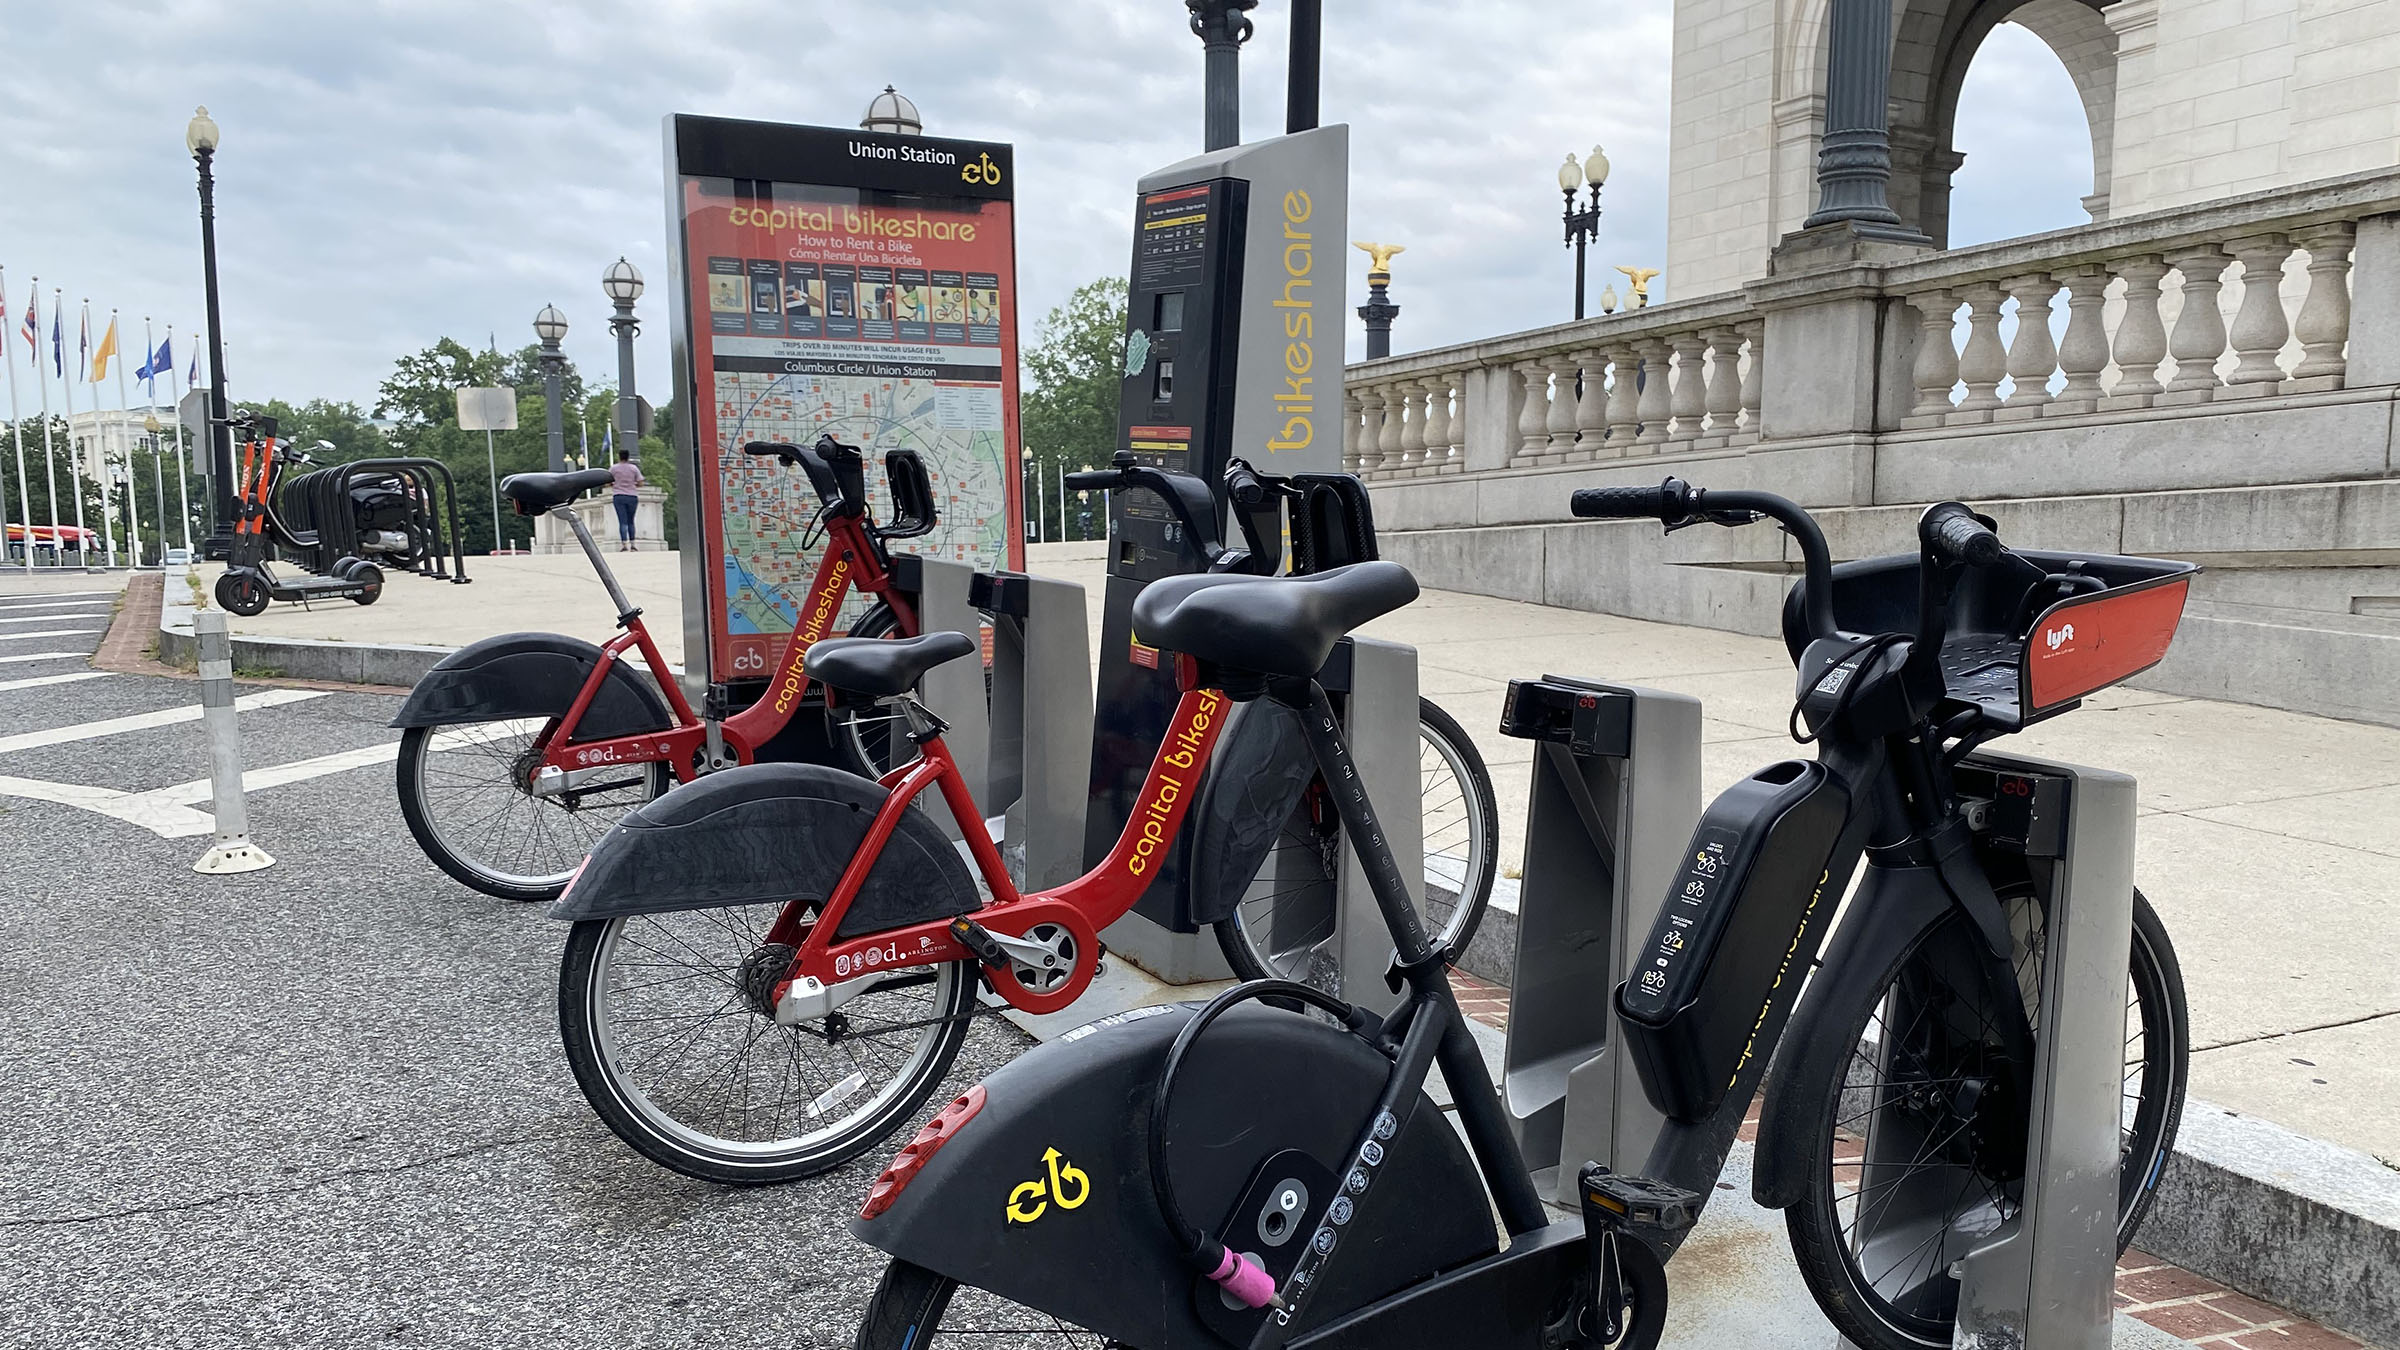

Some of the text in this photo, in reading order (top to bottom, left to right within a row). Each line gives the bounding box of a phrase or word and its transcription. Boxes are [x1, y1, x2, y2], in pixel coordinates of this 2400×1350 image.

[848, 141, 956, 165] Union Station
[728, 204, 976, 242] capital bikeshare
[798, 234, 913, 253] How to Rent a Bike
[789, 247, 922, 267] Cómo Rentar Una Bicicleta
[1265, 188, 1314, 455] bikeshare
[782, 341, 801, 349] TRIPS
[802, 342, 822, 350] OVER
[784, 361, 835, 374] Columbus
[836, 363, 865, 375] Circle
[872, 364, 901, 376] Union
[904, 366, 937, 377] Station
[775, 647, 806, 713] capital
[797, 560, 848, 644] bikeshare
[2047, 623, 2074, 650] lyft
[1129, 688, 1220, 876] capital bikesh
[907, 945, 947, 956] ARLINGTON
